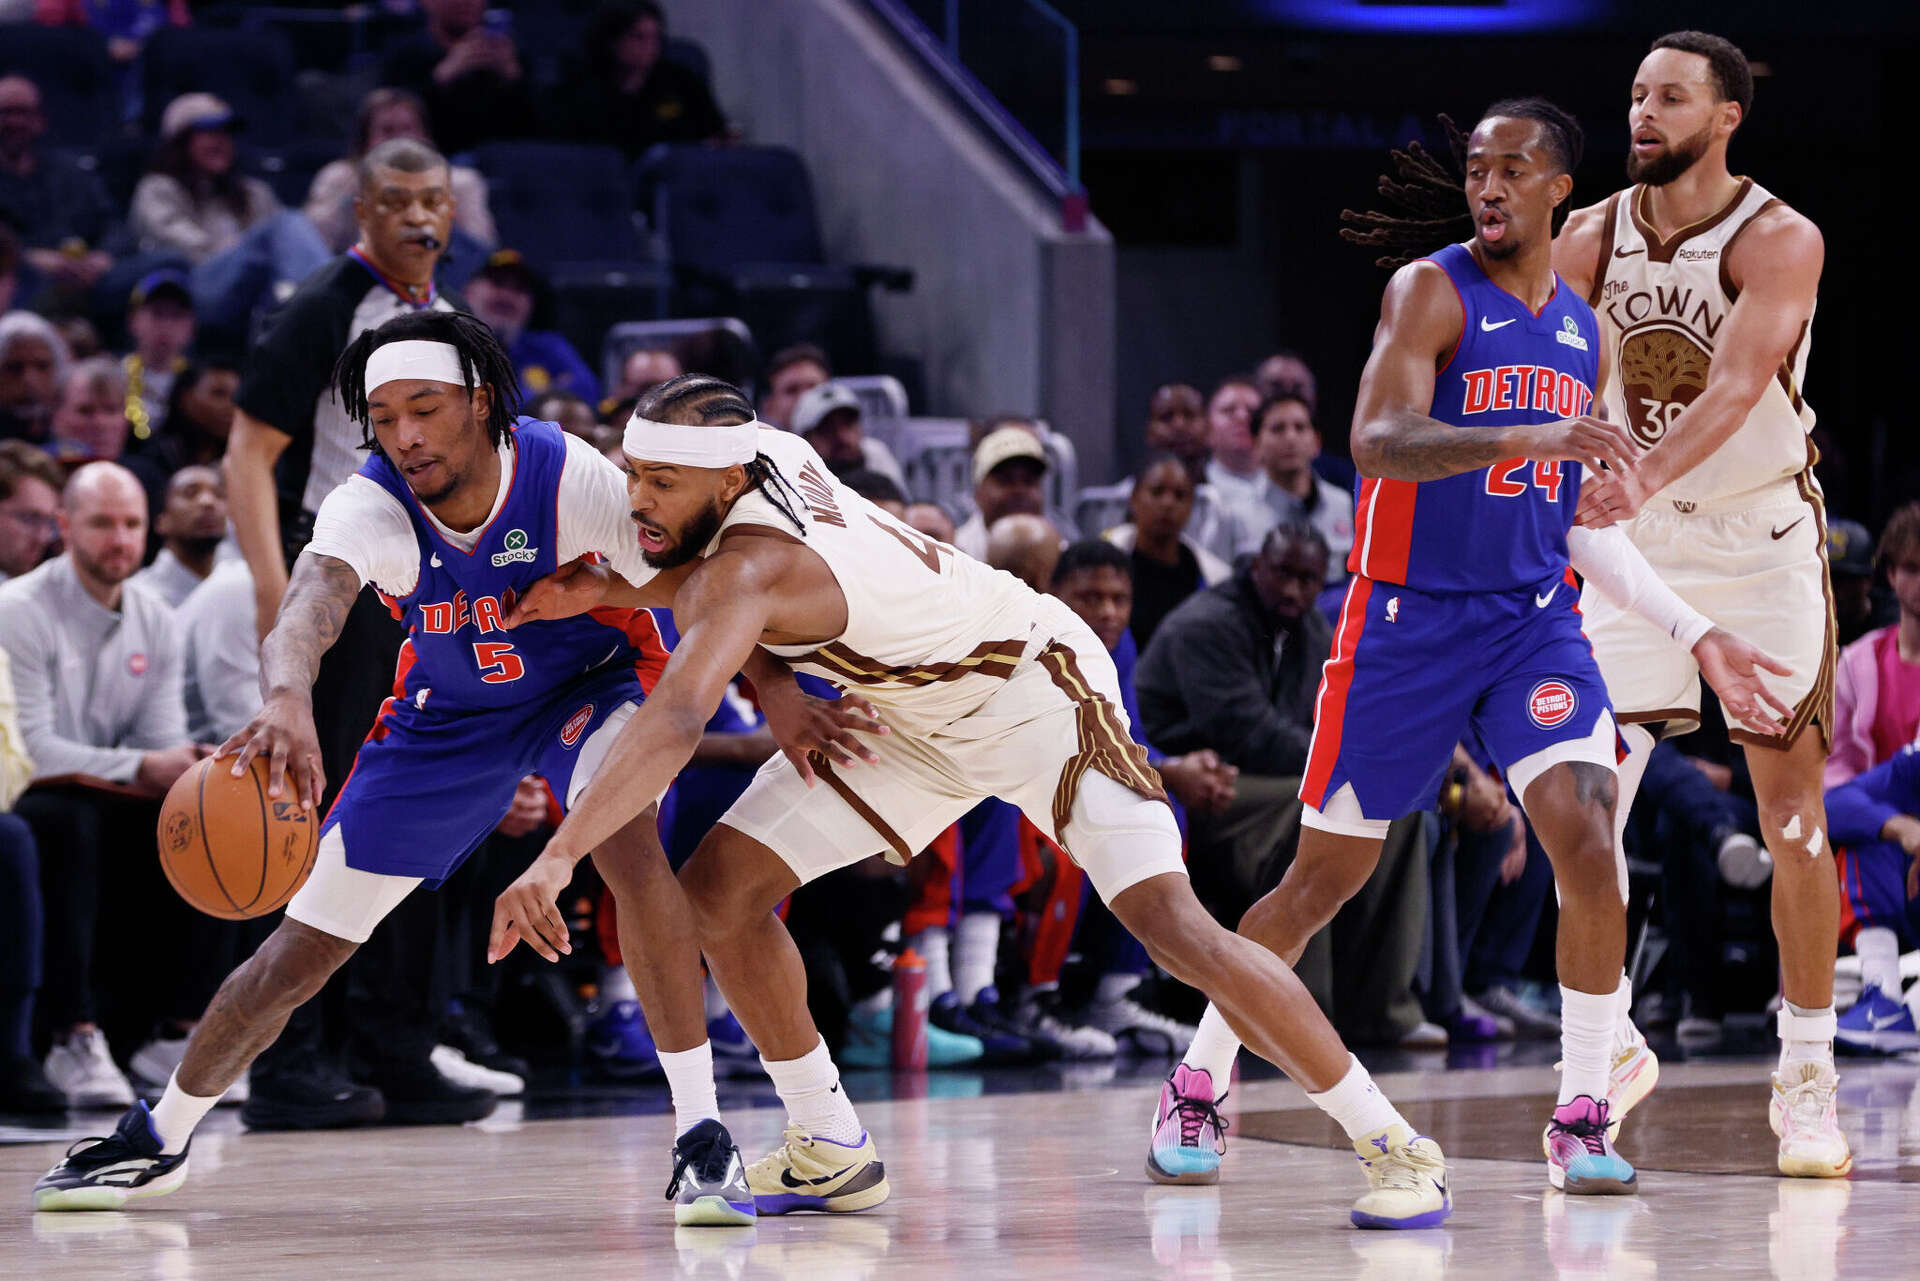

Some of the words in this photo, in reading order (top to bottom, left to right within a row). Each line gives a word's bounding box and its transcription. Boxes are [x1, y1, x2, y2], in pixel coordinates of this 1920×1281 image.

[1679, 249, 1719, 262] Rakuten
[1604, 279, 1630, 300] The
[1607, 286, 1724, 339] TOWN
[1462, 364, 1594, 419] DETROIT
[798, 460, 847, 529] MOODY
[1486, 456, 1564, 503] 24
[493, 549, 538, 566] StockX
[865, 513, 955, 575] 4
[472, 642, 525, 684] 5
[1536, 693, 1567, 706] DETROIT
[1537, 702, 1569, 715] PISTONS
